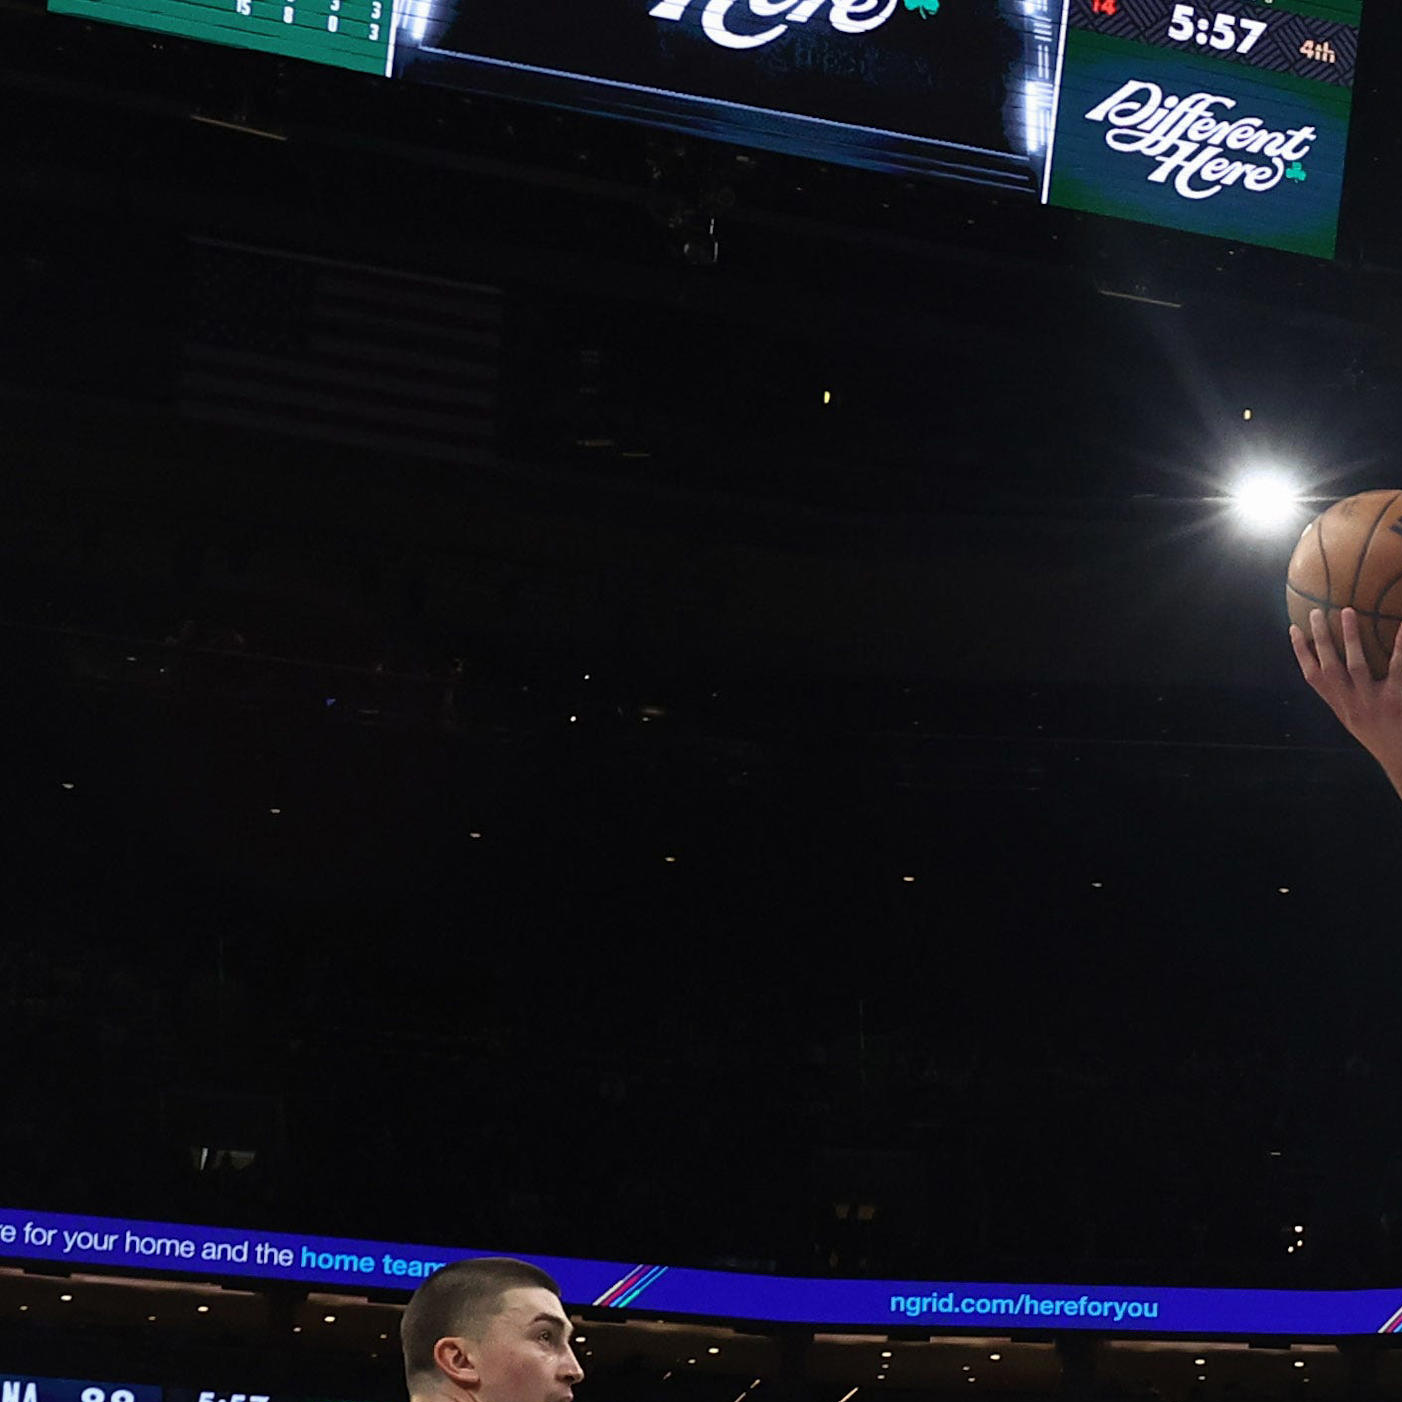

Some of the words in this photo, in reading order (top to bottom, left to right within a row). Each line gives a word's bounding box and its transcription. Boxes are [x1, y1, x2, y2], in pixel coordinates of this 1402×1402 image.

[368, 23, 381, 41] 3
[1168, 3, 1267, 54] 5:57
[1299, 39, 1336, 64] 4th
[1085, 79, 1317, 161] Different
[1106, 128, 1285, 200] Here
[23, 1222, 58, 1246] for
[63, 1230, 119, 1254] your
[125, 1231, 196, 1259] home
[202, 1241, 249, 1263] and
[255, 1242, 294, 1267] the
[300, 1246, 376, 1274] home
[889, 1292, 1159, 1323] ngrid.com/hereforyou
